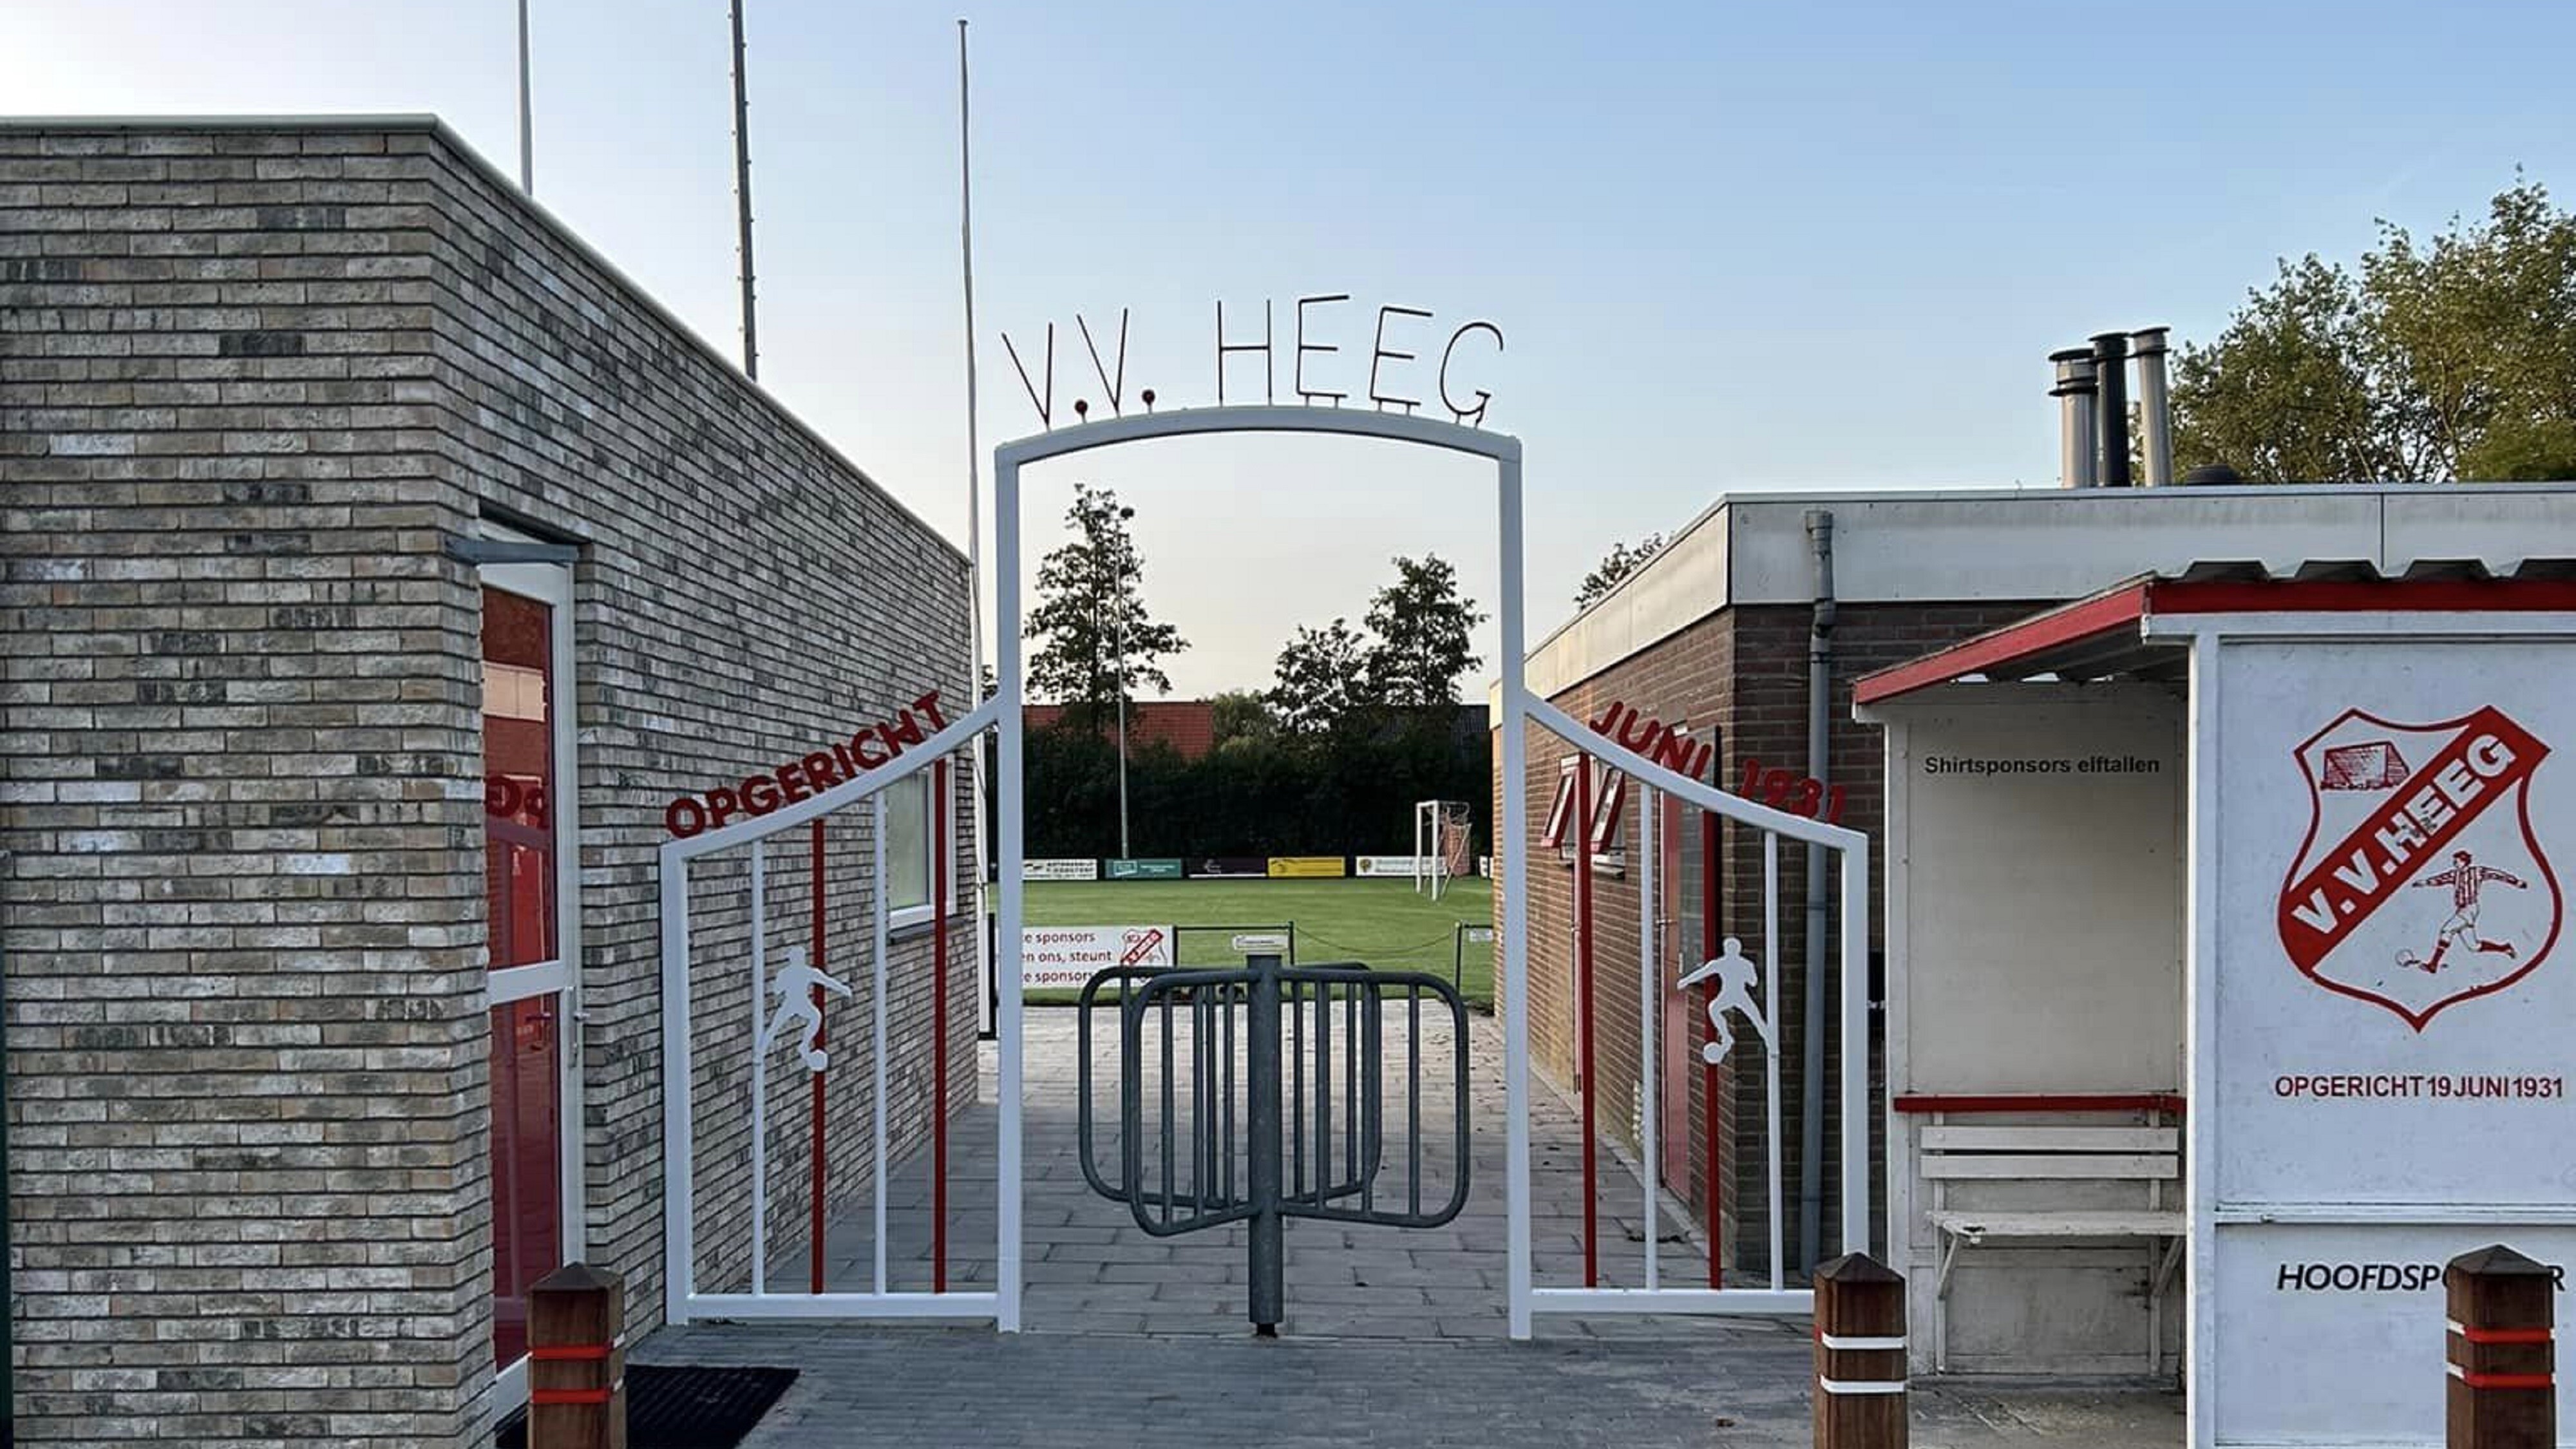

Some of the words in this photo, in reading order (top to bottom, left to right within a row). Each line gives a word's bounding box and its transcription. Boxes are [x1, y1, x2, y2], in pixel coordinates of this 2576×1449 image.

[1002, 308, 1155, 425] V.V.
[1218, 295, 1504, 424] HEEG
[665, 690, 949, 838] OPGERICHT
[1589, 701, 1712, 780] JUNI
[1739, 759, 1848, 825] 1931
[1924, 756, 2071, 777] Shirtsponsors
[2078, 755, 2160, 773] elftallen
[2291, 733, 2517, 935] V.V.HEEG
[1036, 933, 1095, 945] sponsors
[1038, 953, 1066, 963] ons,
[1070, 951, 1112, 962] steunt
[2275, 1075, 2424, 1097] OPGERICHT
[2427, 1075, 2450, 1097] 19
[2454, 1075, 2509, 1097] JUNI
[2513, 1075, 2563, 1097] 1931
